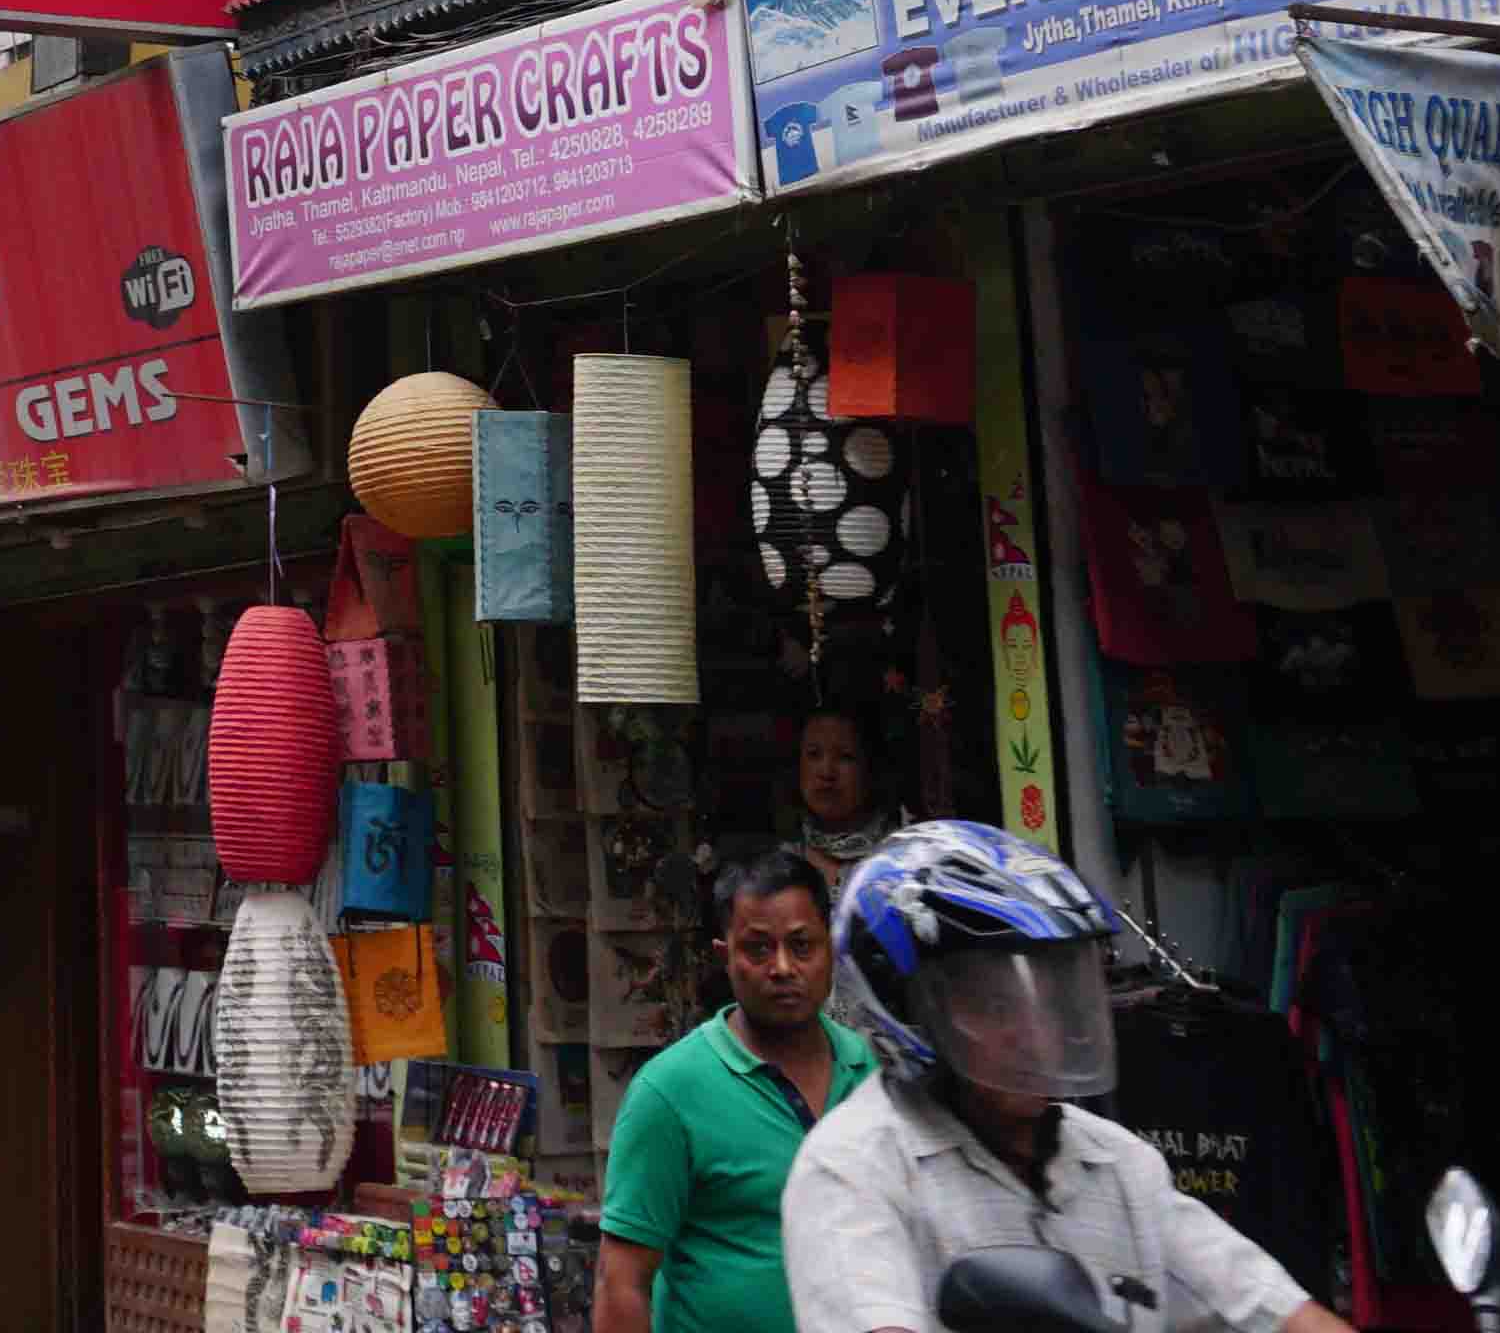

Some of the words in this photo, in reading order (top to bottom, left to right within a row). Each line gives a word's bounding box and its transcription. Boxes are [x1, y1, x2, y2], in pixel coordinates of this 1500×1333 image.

[244, 111, 349, 207] RAJA
[357, 61, 506, 176] PAPER
[511, 4, 714, 136] CRAFTS
[916, 91, 1048, 145] Manufacturer
[1053, 81, 1072, 109] &
[1073, 55, 1195, 106] Wholesaler
[15, 359, 179, 444] GEMS
